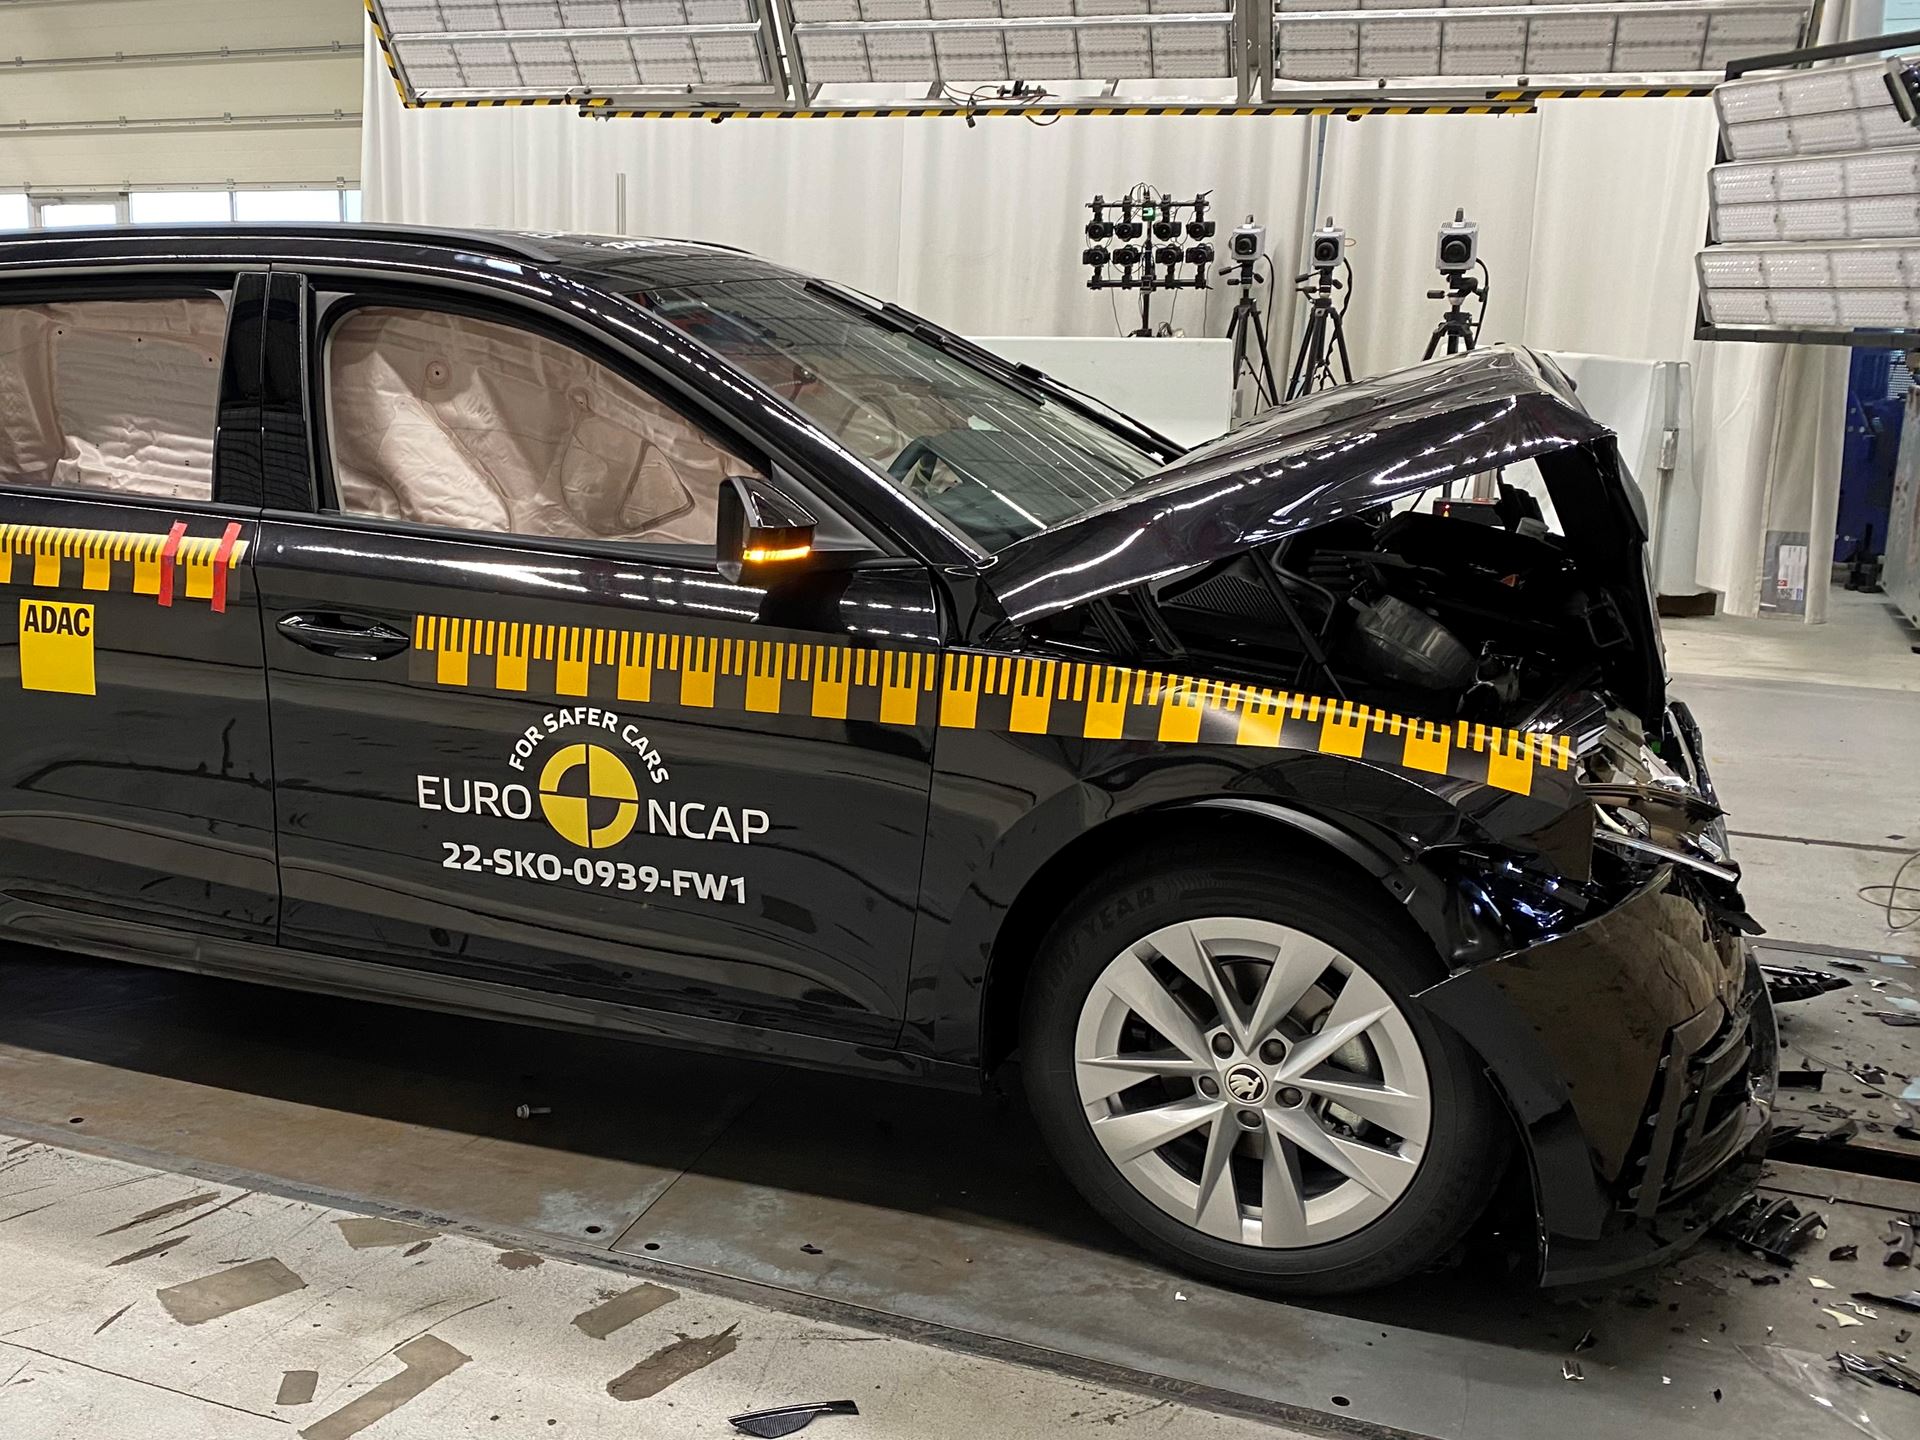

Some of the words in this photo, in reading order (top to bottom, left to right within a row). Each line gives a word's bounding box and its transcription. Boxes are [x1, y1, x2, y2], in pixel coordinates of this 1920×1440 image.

[23, 604, 91, 637] ADAC
[508, 725, 546, 772] FOR
[542, 706, 619, 734] SAFER
[621, 724, 670, 785] CARS
[416, 774, 532, 820] EURO
[648, 798, 770, 844] NCAP
[441, 841, 746, 905] 22-SKO-0939-FW1
